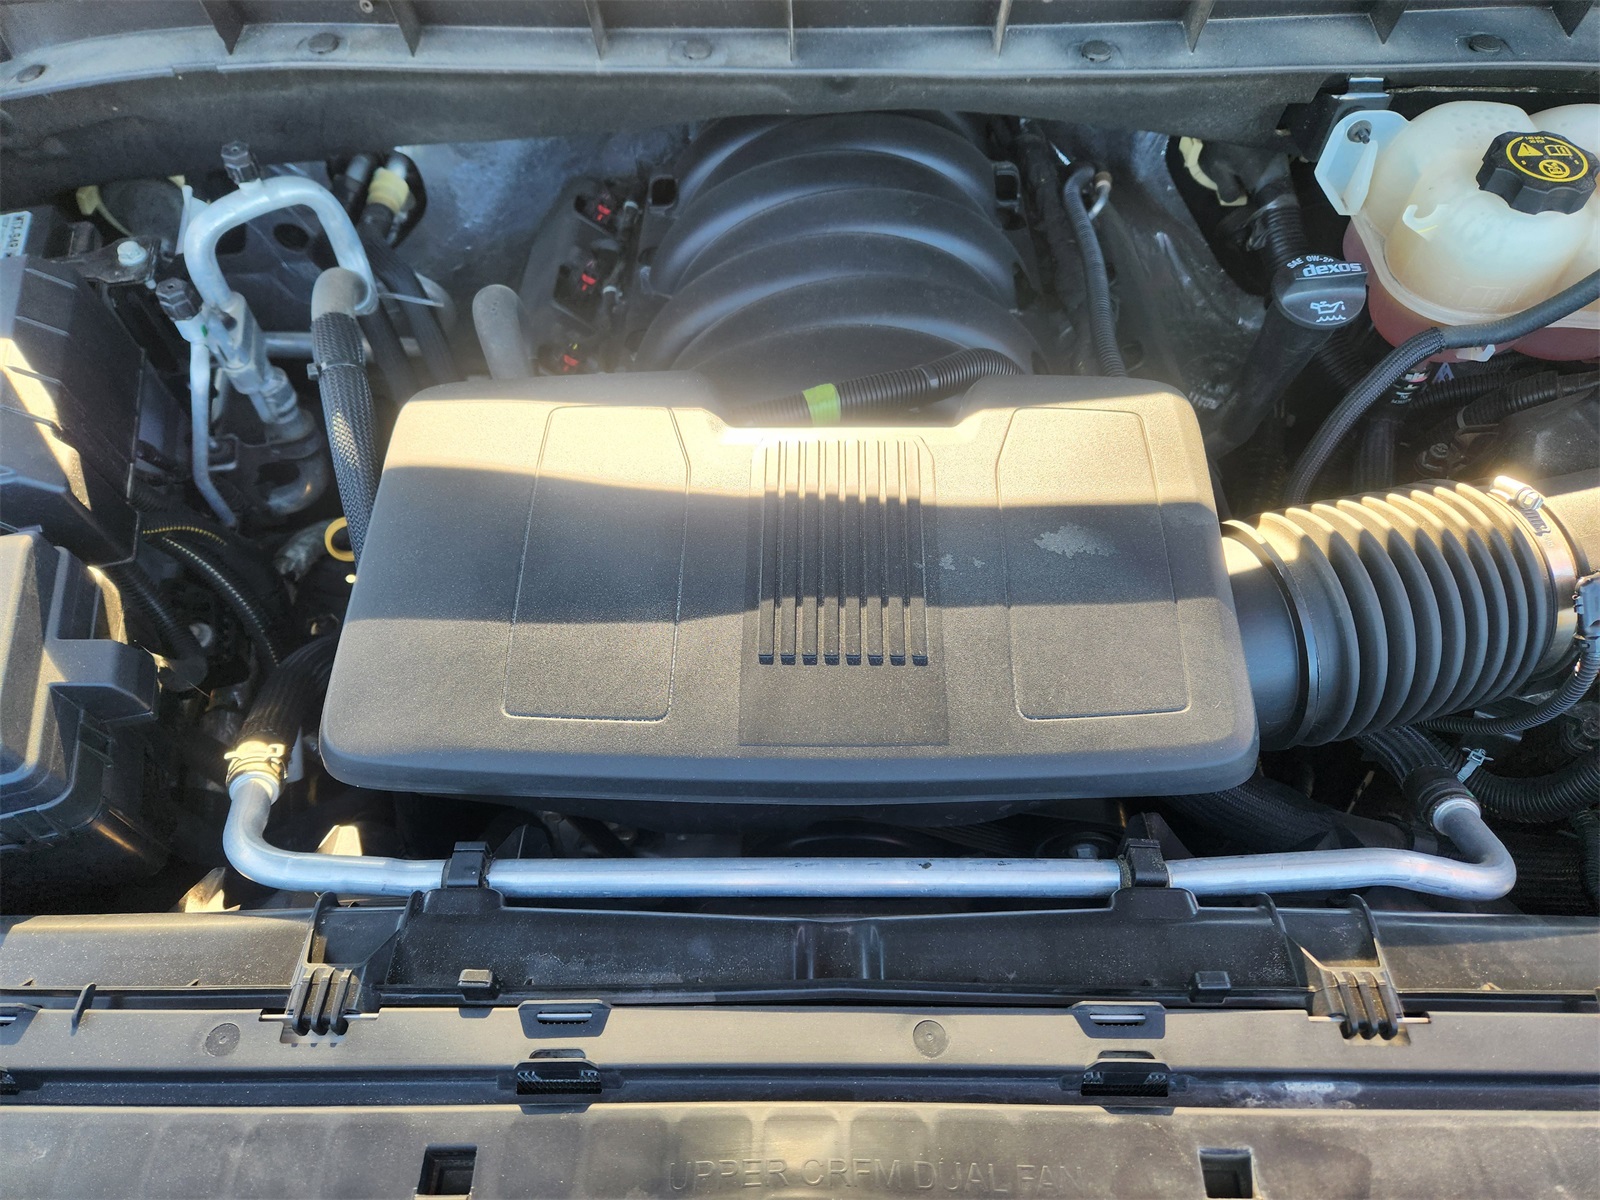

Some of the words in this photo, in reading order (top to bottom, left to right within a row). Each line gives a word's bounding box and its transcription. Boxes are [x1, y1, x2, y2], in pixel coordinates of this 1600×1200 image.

[1287, 257, 1304, 269] SAE
[1303, 263, 1362, 277] dexos
[669, 1158, 790, 1190] UPPER
[802, 1159, 900, 1189] CRFM
[914, 1160, 1008, 1192] DUAL
[1017, 1164, 1085, 1194] FAN
